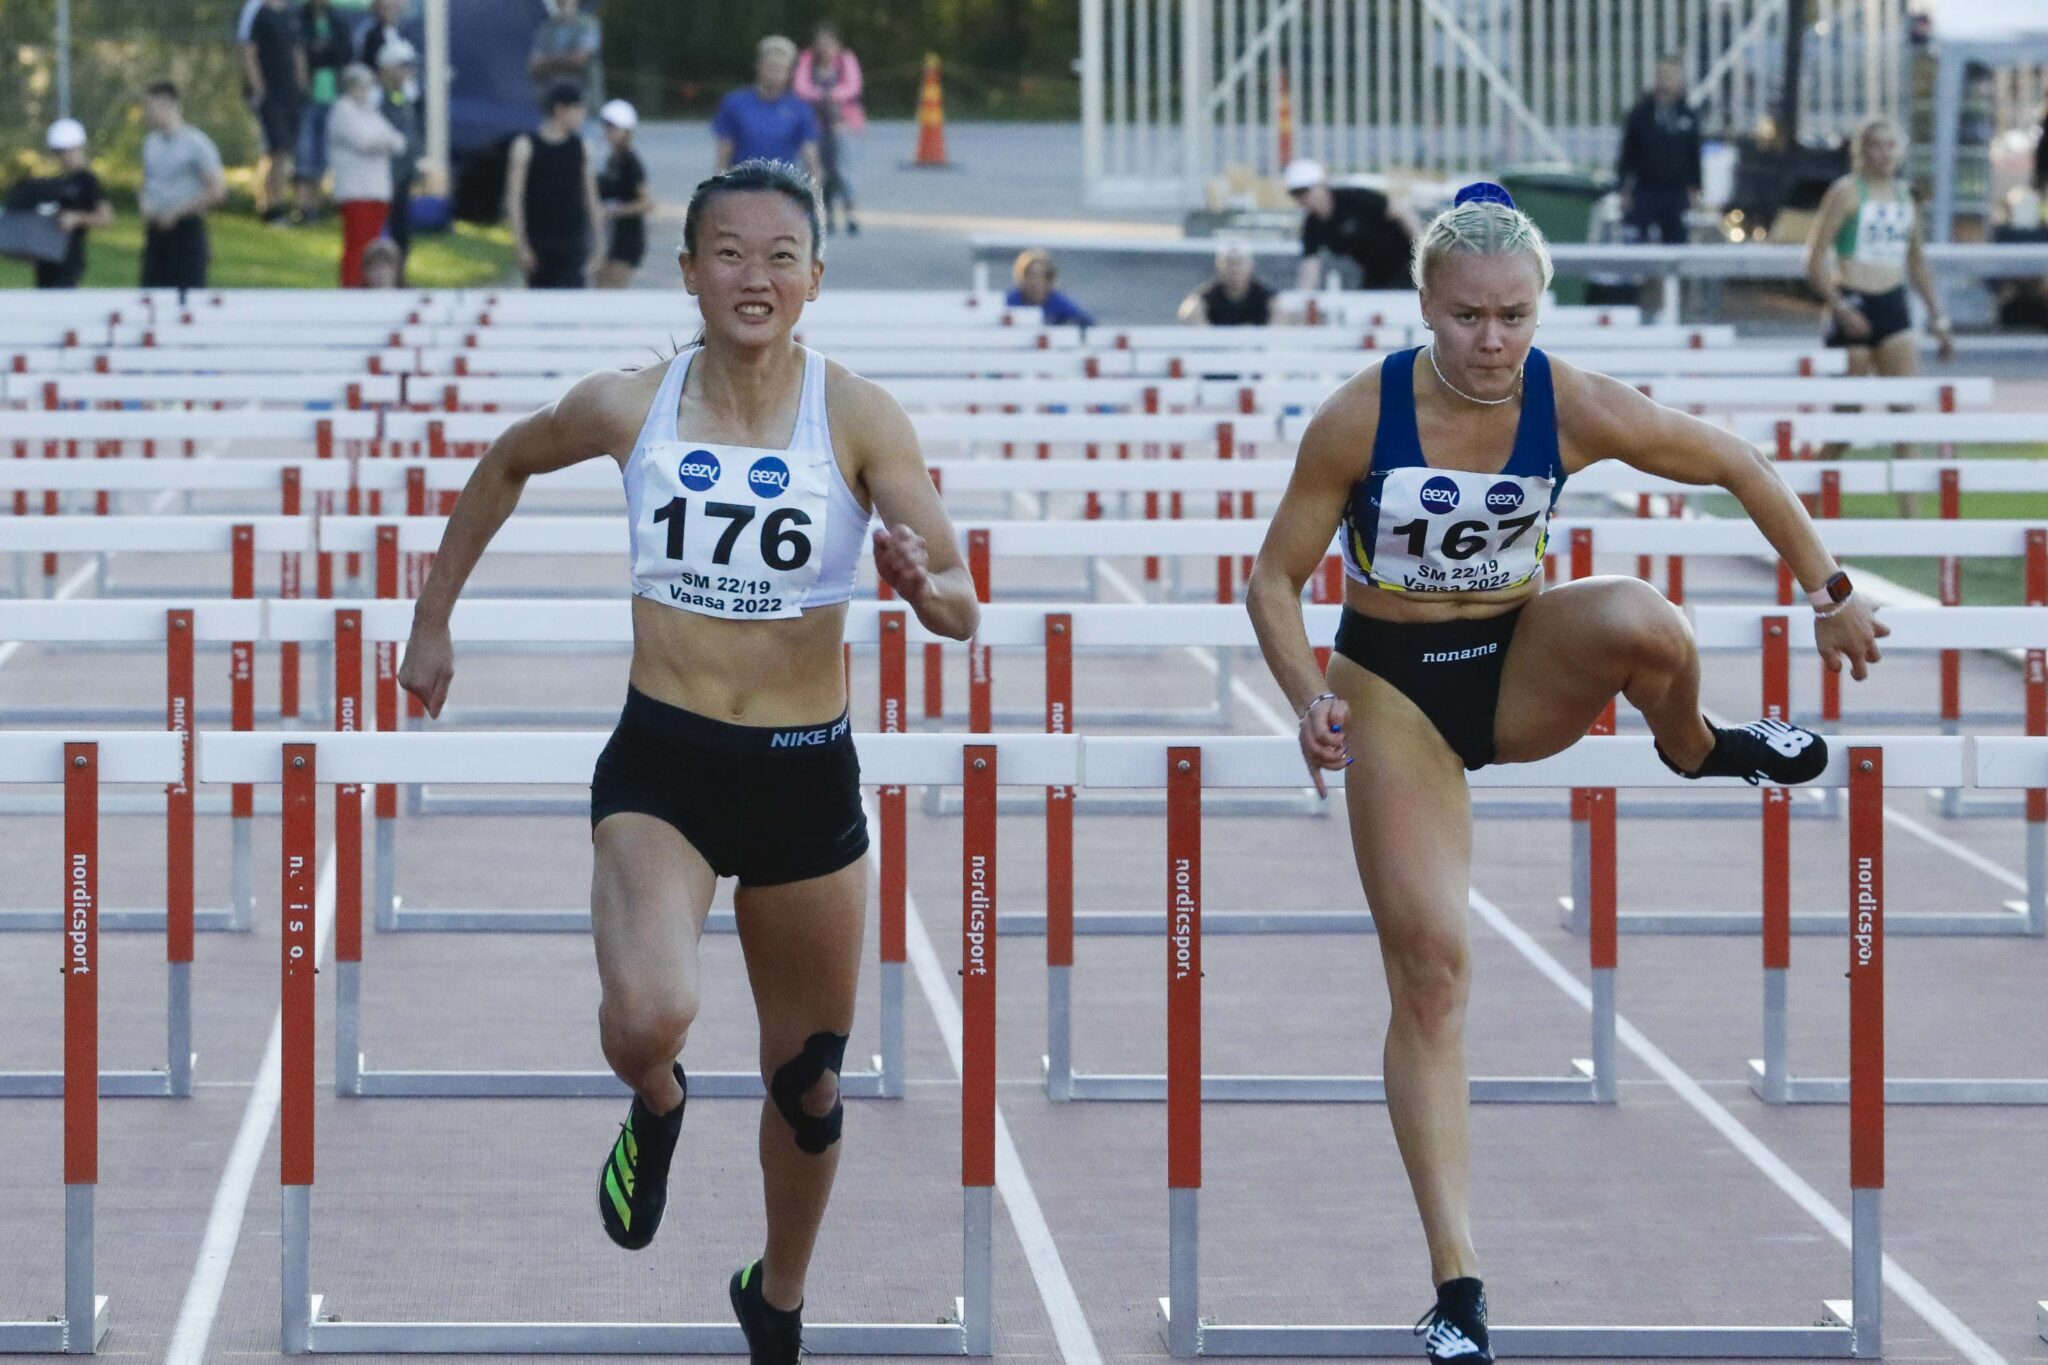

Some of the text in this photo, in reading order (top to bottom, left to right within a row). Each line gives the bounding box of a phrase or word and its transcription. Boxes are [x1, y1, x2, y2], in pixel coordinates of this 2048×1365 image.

[680, 462, 720, 484] eezy
[750, 469, 789, 490] eezy
[1422, 487, 1460, 508] eezy
[1487, 493, 1524, 508] eezy
[653, 496, 812, 571] 176
[1393, 510, 1541, 560] 167
[1418, 560, 1499, 581] SM 22/19
[681, 572, 771, 595] SM 22/19
[1468, 572, 1510, 591] 2022
[669, 584, 782, 613] Vaasa 2022
[1422, 642, 1498, 663] noname
[770, 729, 827, 747] NIKE
[69, 853, 92, 975] nordicsport
